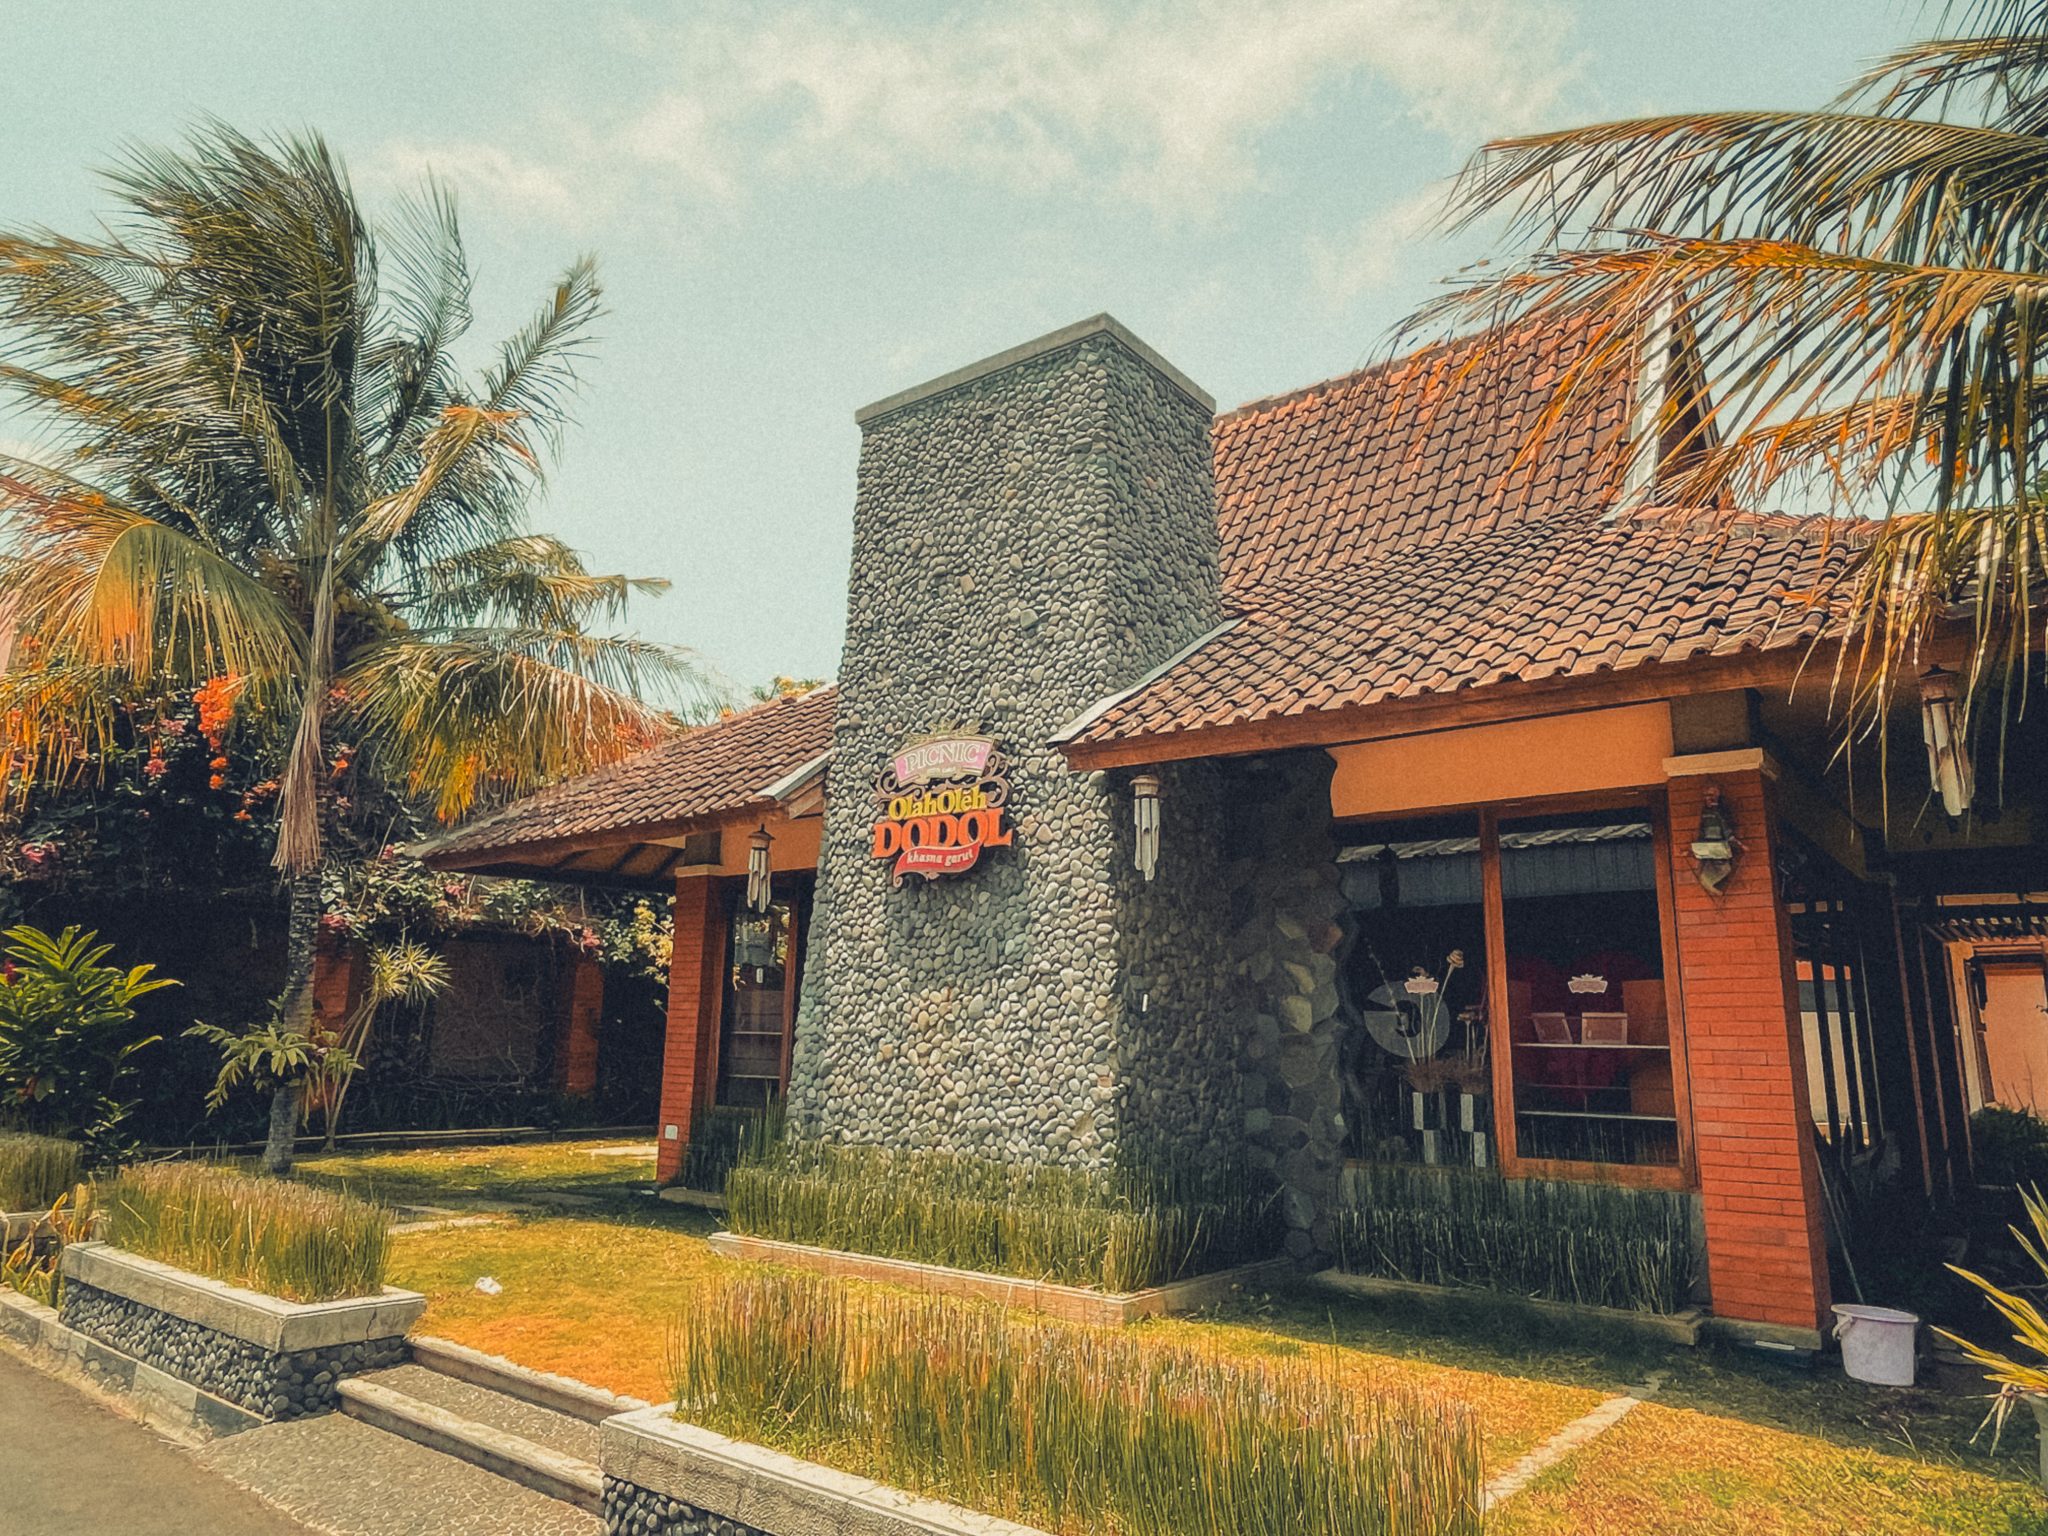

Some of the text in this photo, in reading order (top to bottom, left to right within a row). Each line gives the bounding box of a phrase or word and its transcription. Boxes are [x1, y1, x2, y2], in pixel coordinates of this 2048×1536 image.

[905, 743, 980, 774] PICNIC
[871, 808, 1013, 858] DODOL
[944, 848, 974, 867] garut
